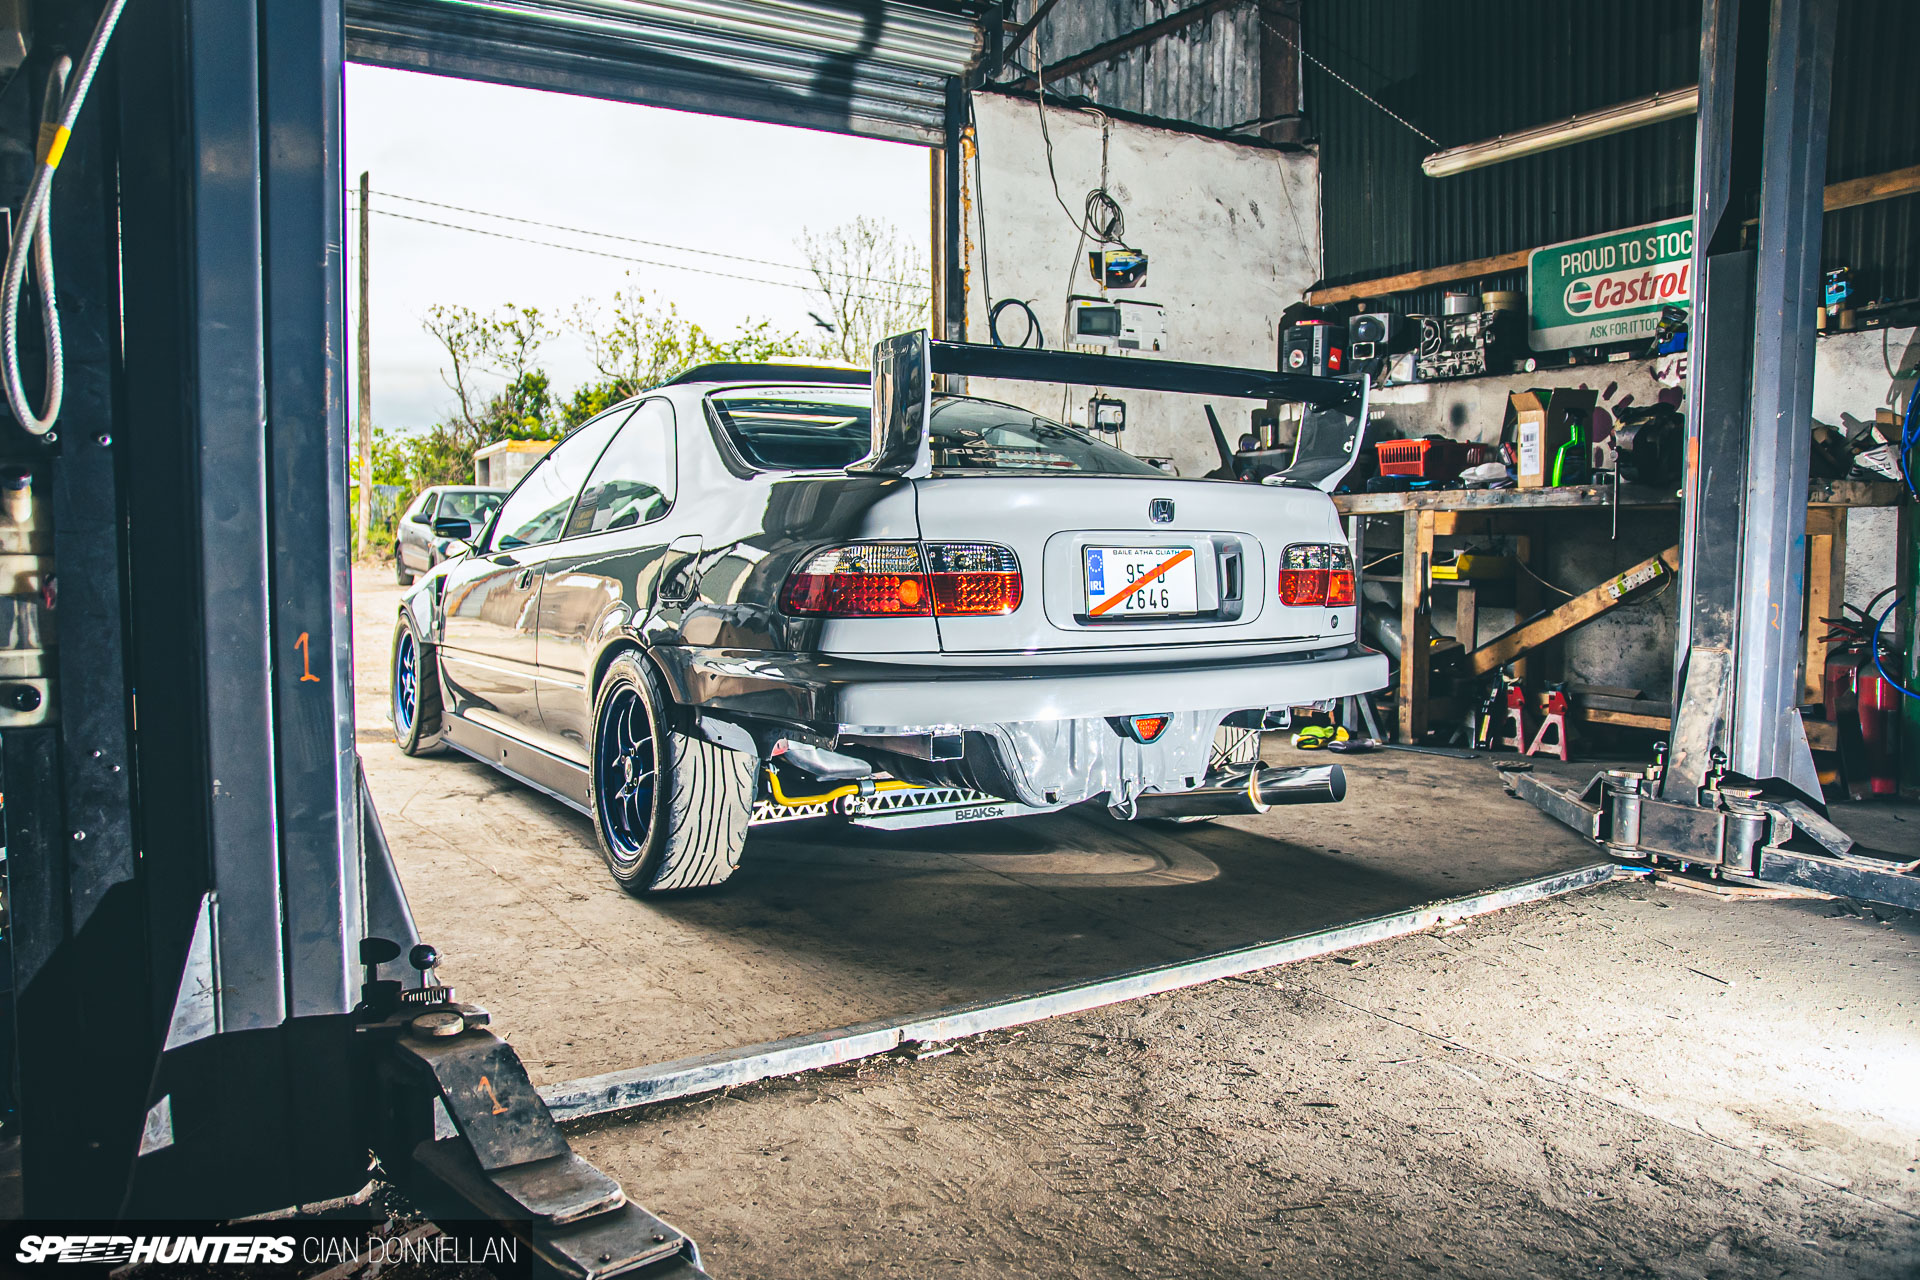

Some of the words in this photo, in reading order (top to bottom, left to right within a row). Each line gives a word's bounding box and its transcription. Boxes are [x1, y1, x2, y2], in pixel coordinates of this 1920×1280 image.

[1561, 246, 1616, 276] PROUD
[1619, 240, 1641, 265] TO
[1646, 230, 1691, 260] STOC
[1594, 265, 1689, 309] Castrol
[1590, 325, 1607, 338] ASK
[1610, 322, 1628, 335] FOR
[1630, 320, 1638, 333] IT
[1640, 318, 1659, 332] TOD
[1090, 580, 1104, 591] IRL
[1771, 603, 1780, 630] 2
[294, 631, 320, 682] 1
[955, 806, 996, 821] BEAKS
